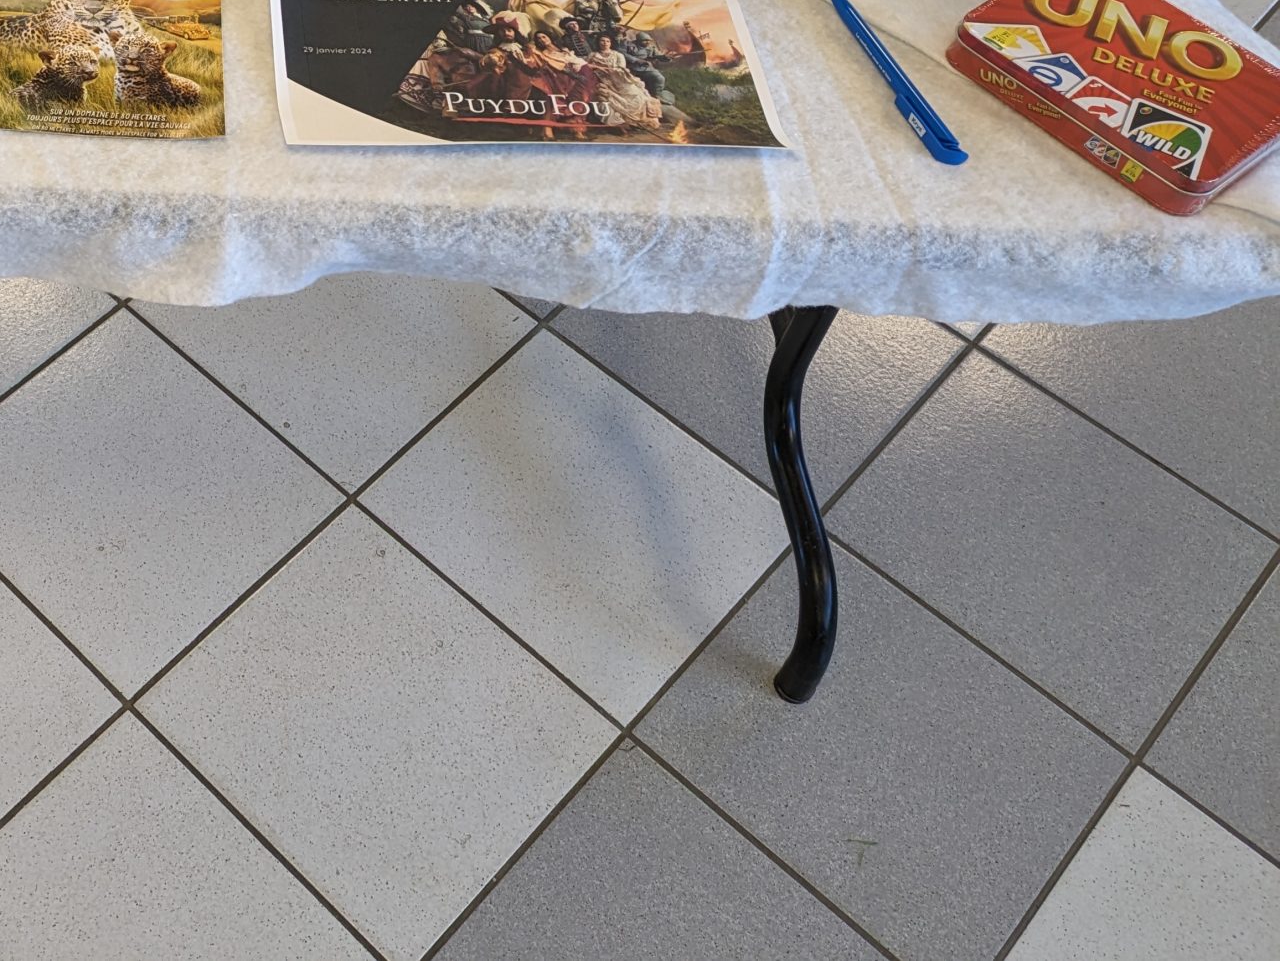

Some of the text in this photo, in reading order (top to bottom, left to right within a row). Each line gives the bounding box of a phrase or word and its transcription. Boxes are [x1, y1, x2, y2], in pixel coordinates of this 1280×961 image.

[316, 46, 347, 55] janvier
[350, 47, 373, 55] 2024
[980, 68, 1017, 90] UNO
[1091, 46, 1217, 105] DELUXE
[1143, 89, 1198, 115] Everyone!
[26, 114, 61, 123] TOUJOURS
[161, 122, 192, 130] SAUVAGE
[76, 110, 109, 120] DOMAINE
[1135, 131, 1192, 160] WILD
